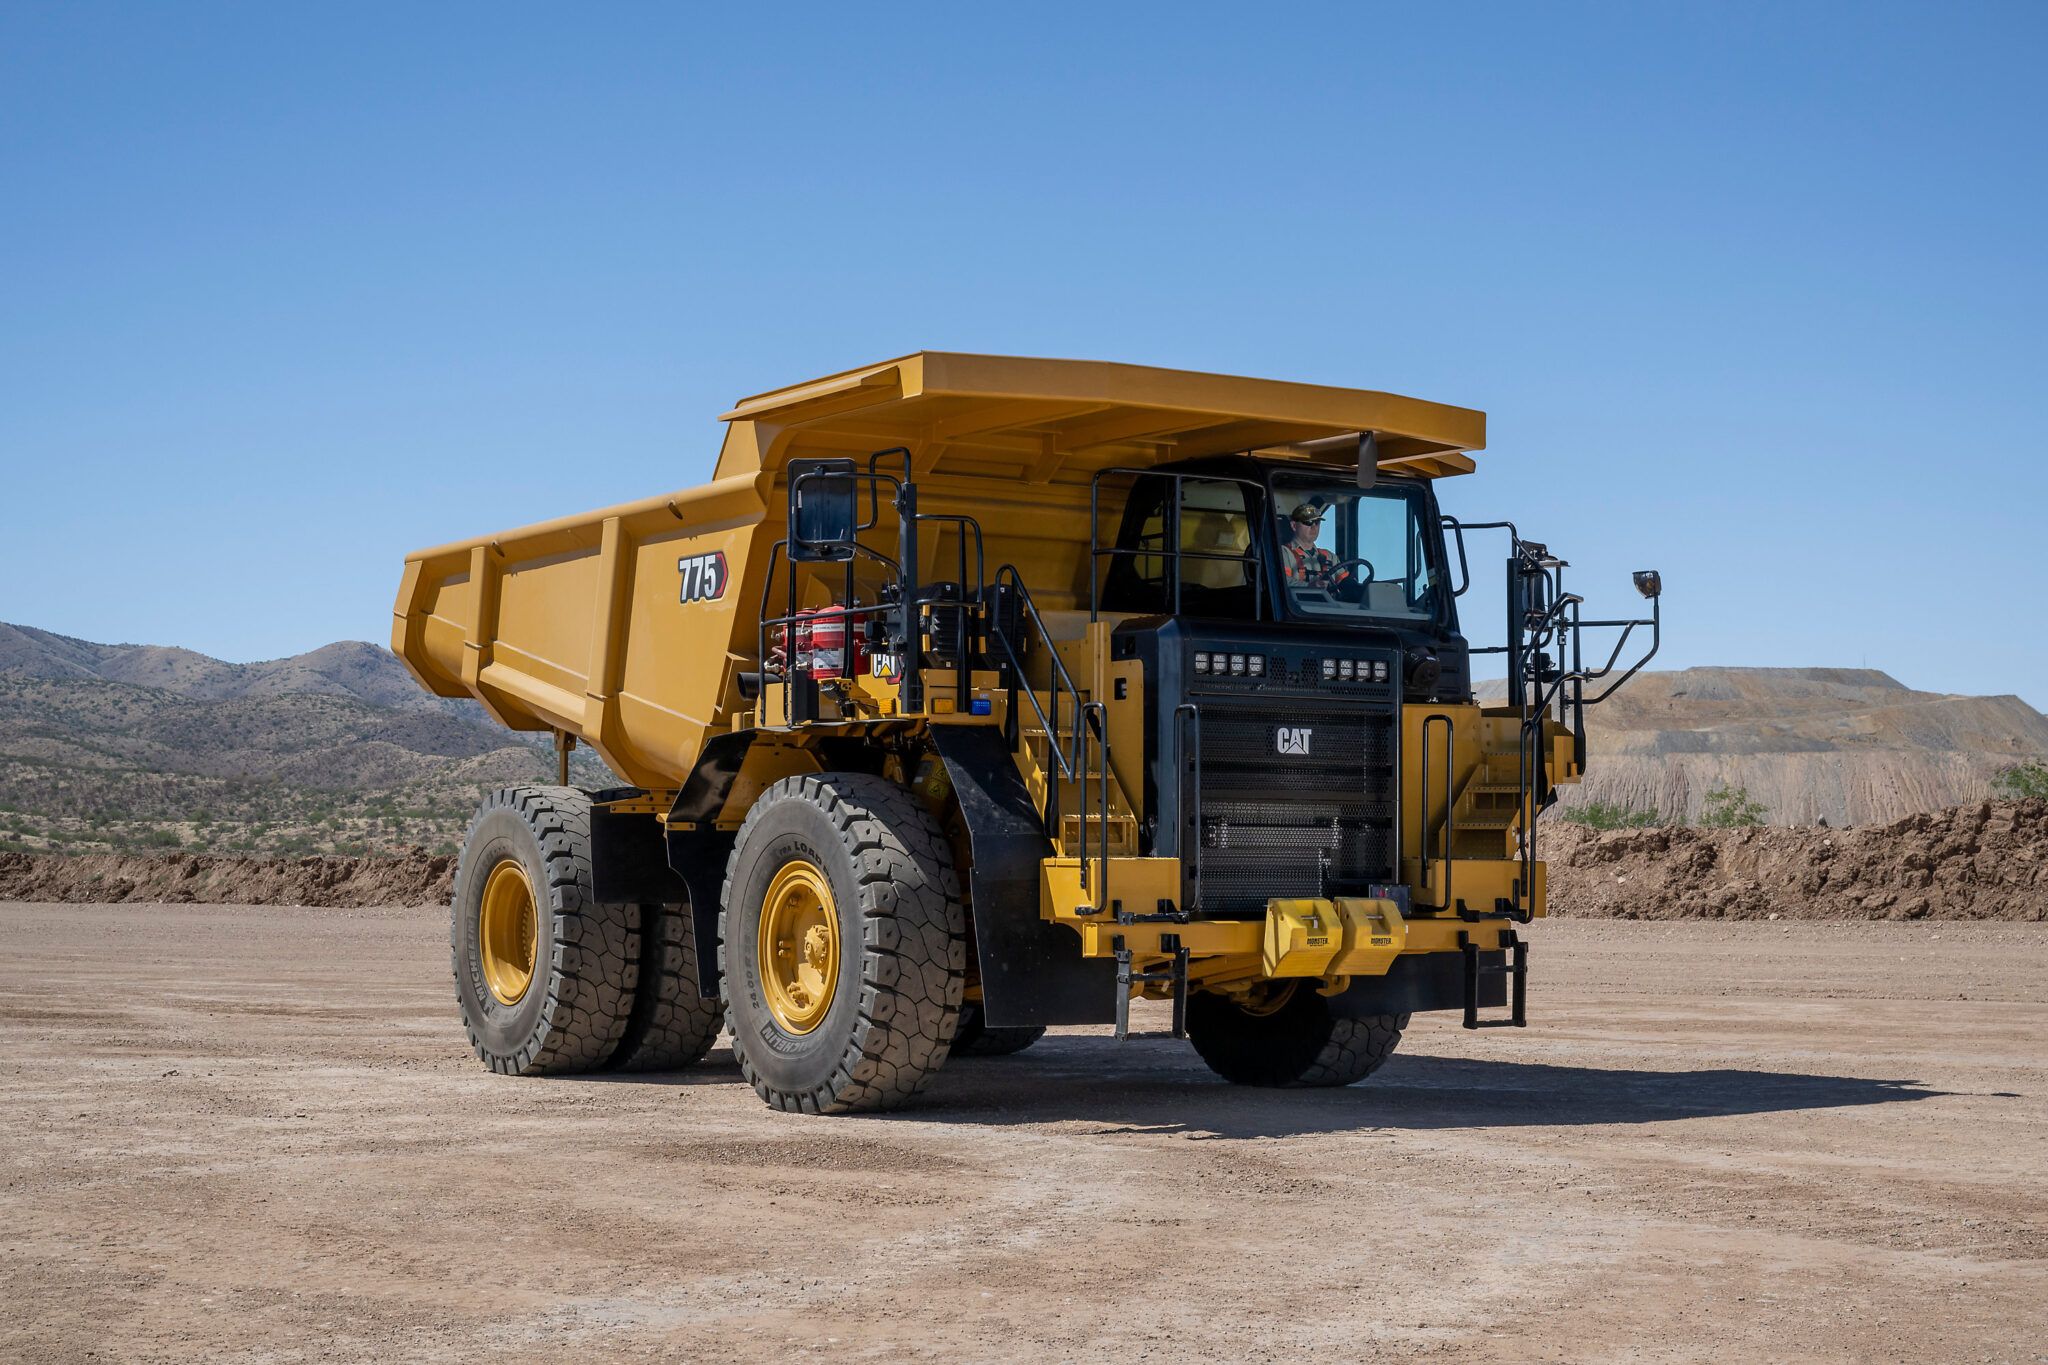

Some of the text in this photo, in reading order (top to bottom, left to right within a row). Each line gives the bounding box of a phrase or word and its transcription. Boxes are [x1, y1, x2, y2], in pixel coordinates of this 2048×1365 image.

[679, 554, 717, 601] 775
[1277, 727, 1312, 755] CAT
[794, 841, 823, 866] LOAD
[468, 917, 488, 1002] MICHELIN
